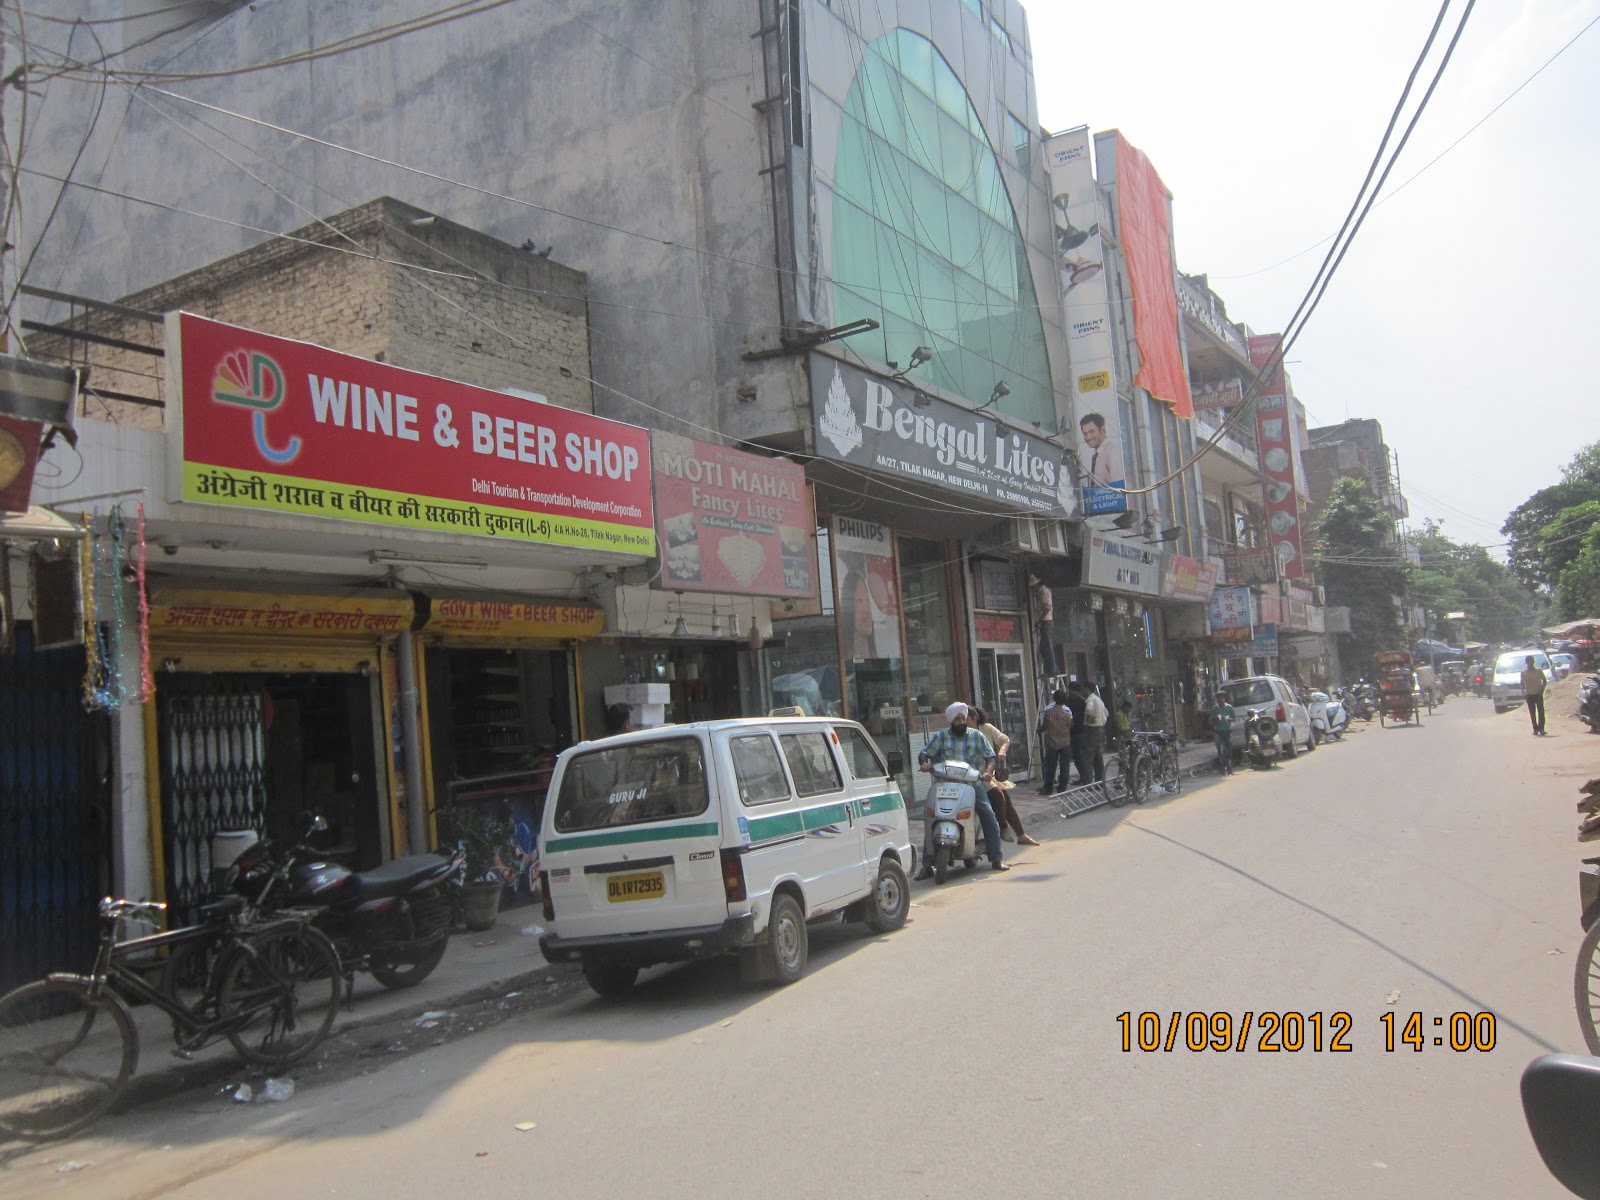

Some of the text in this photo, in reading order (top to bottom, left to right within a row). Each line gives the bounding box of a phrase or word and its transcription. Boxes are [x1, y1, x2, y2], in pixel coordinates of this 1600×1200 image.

[1055, 146, 1085, 158] ORIENT
[1073, 318, 1104, 329] ORIENT
[1078, 325, 1100, 334] FANS
[1080, 374, 1106, 382] ORIENT
[307, 373, 639, 482] WINE & BEER SHOP
[863, 378, 1056, 486] Bengal Lites
[663, 451, 723, 487] MOTI
[730, 466, 801, 503] MAHAL
[900, 461, 921, 475] TILAK
[922, 467, 948, 484] NAGAR,
[948, 474, 962, 486] NEW
[196, 469, 267, 504] अंग्रेजी
[272, 483, 324, 509] शराब
[330, 491, 344, 511] व
[349, 489, 393, 518] बीयर
[397, 499, 420, 522] की
[425, 504, 482, 528] सरकारी
[472, 478, 642, 518] Delhi Tourism & Transportation Development Corporation
[691, 486, 784, 522] Fancy Lites
[1100, 500, 1118, 509] LIGHT
[590, 529, 604, 540] Tilak
[623, 533, 635, 544] New
[838, 516, 885, 543] PHILIPS
[480, 601, 514, 620] WINE
[516, 607, 521, 617] &
[524, 604, 558, 623] BEER
[561, 607, 595, 625] SHOP
[609, 788, 647, 804] GURU JI
[690, 851, 714, 860] Omni
